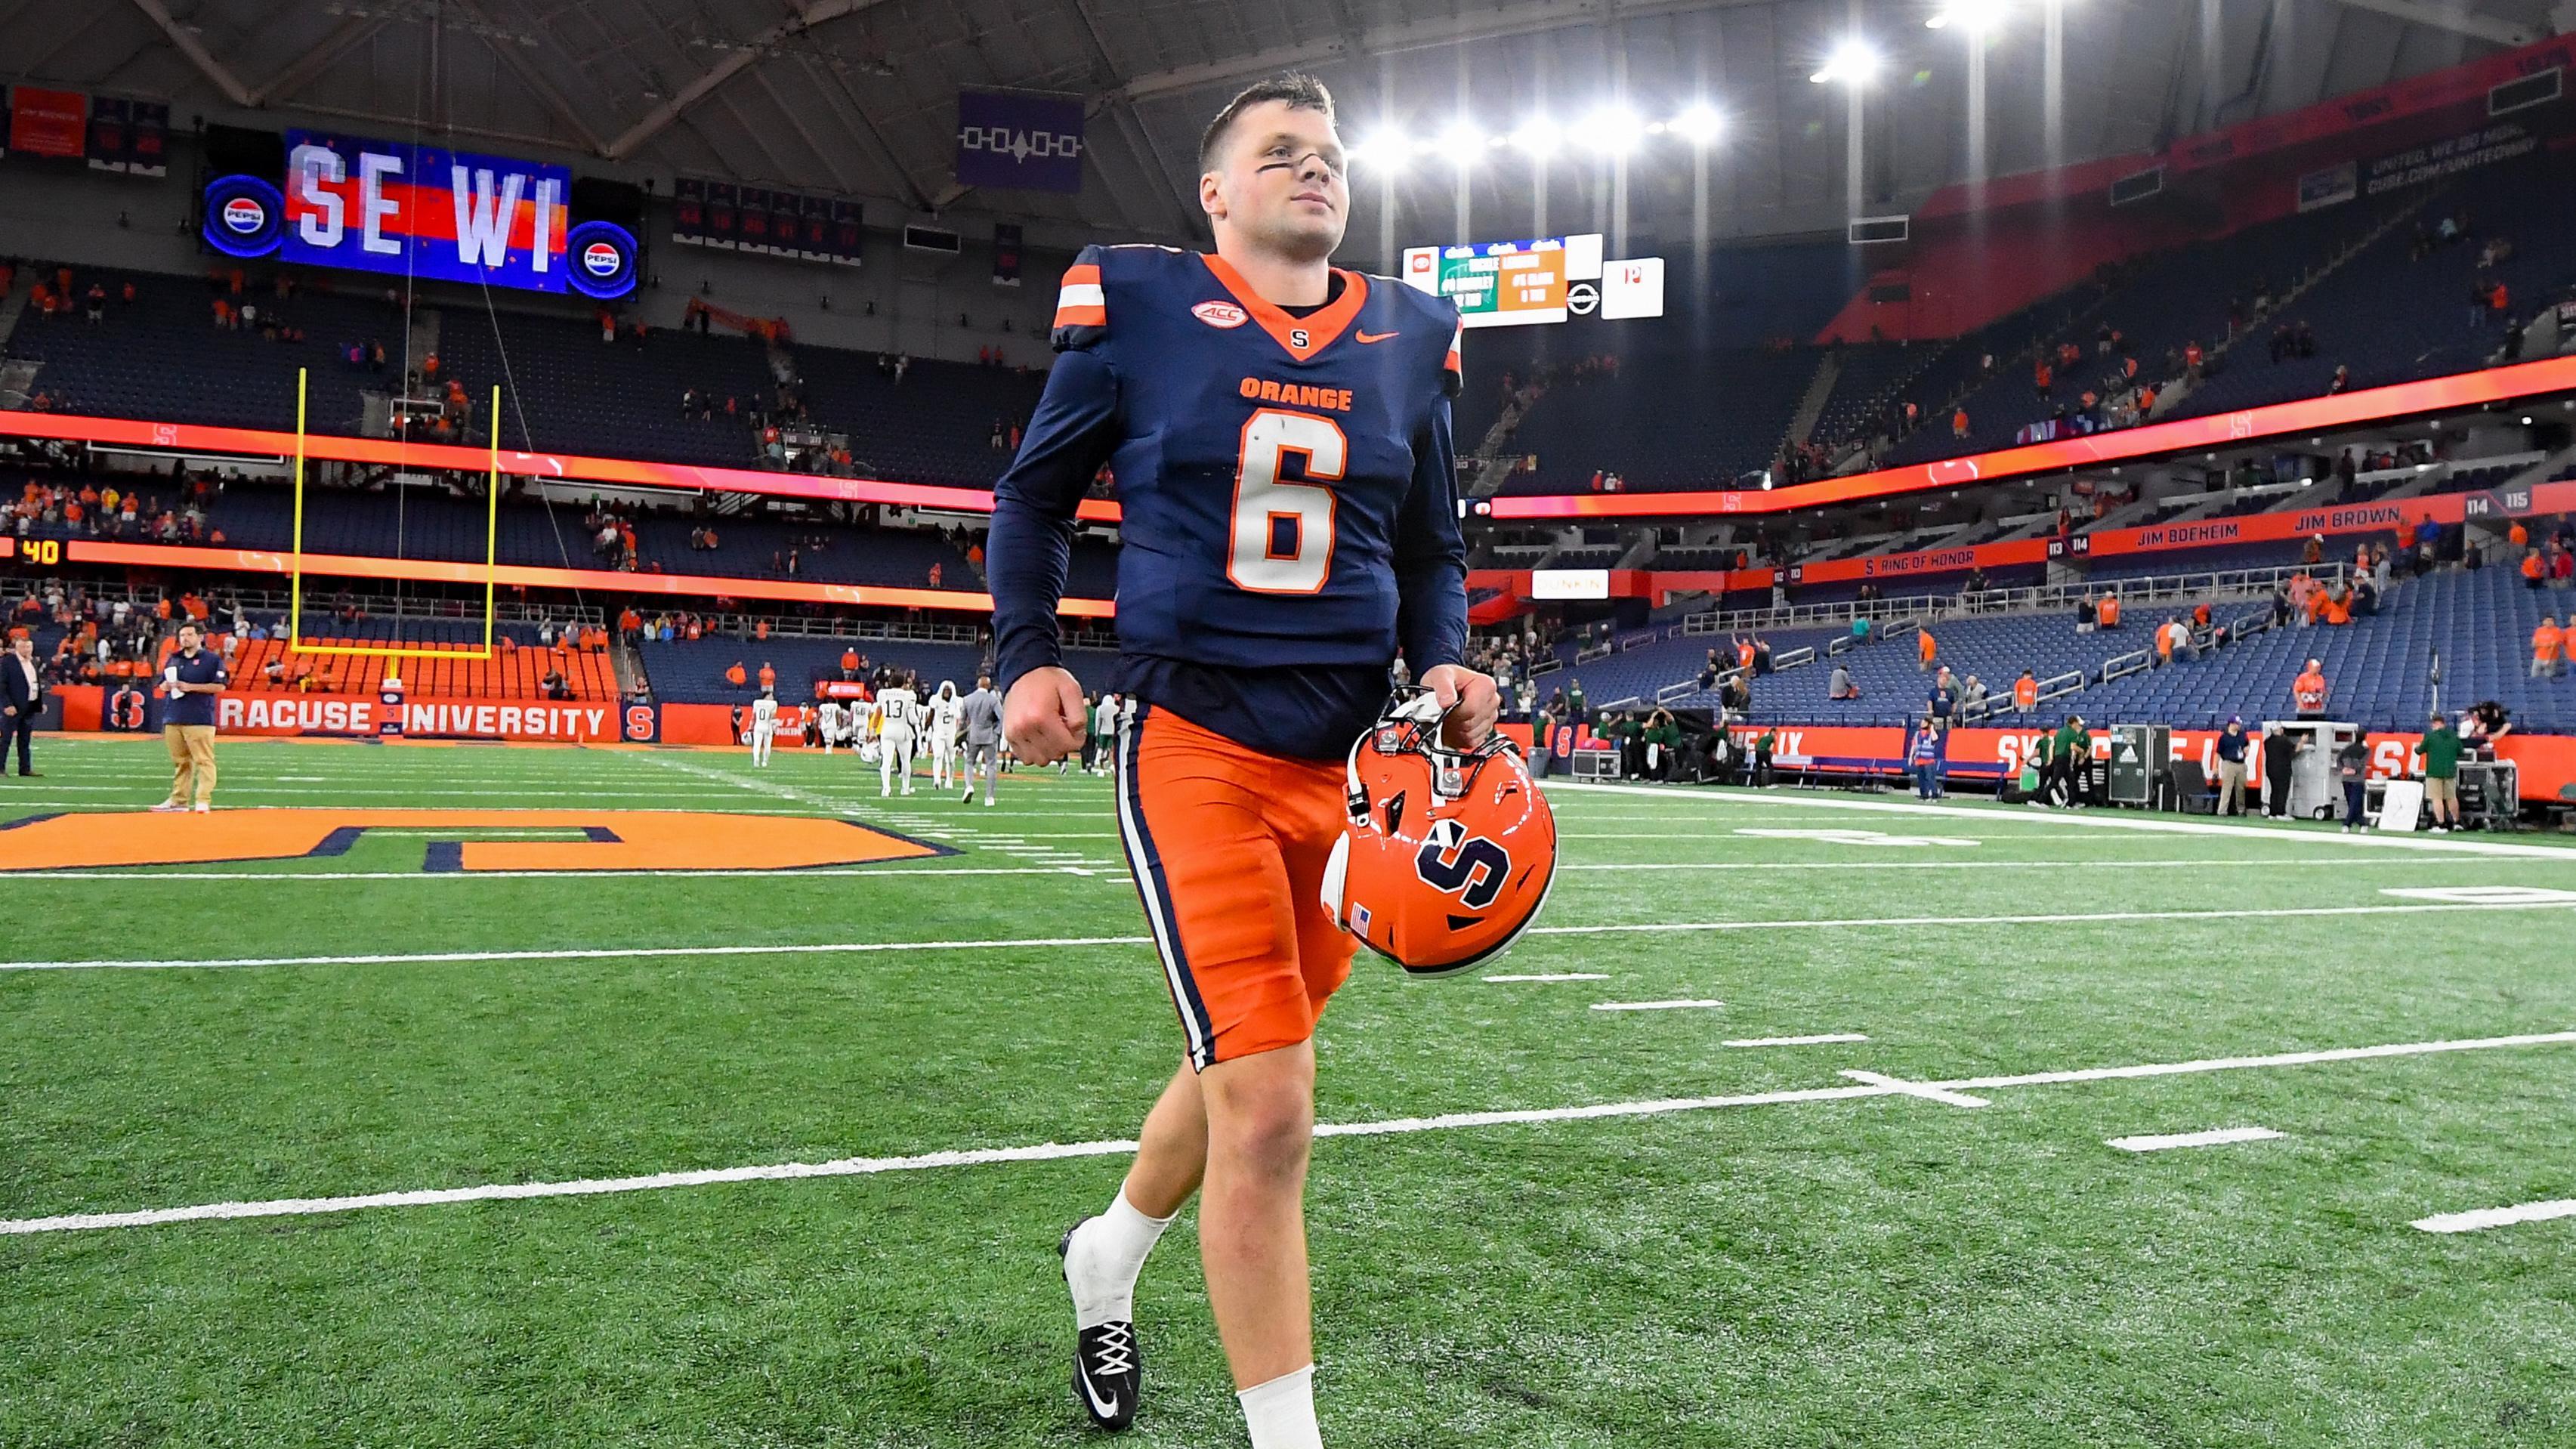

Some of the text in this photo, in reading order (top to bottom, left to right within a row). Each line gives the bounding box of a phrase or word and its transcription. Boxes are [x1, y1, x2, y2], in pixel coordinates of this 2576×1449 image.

[227, 210, 261, 220] PEPSI
[290, 144, 403, 255] SE
[451, 165, 561, 273] WI
[588, 254, 616, 264] PEPSI
[1198, 307, 1239, 321] ACC
[1290, 329, 1310, 349] S
[1240, 377, 1353, 412] ORANGE
[1226, 408, 1348, 595] 6
[2467, 491, 2528, 514] 114 115
[2295, 507, 2401, 532] JIM BROWN
[2049, 537, 2088, 556] 113 114
[2137, 524, 2238, 547] JIM BOEHEIM
[23, 540, 59, 565] 40
[1866, 551, 1974, 575] S RING OF HONOR
[220, 698, 371, 731] RACUSE
[885, 699, 903, 719] 13
[627, 706, 654, 740] S
[1557, 726, 1572, 758] S
[1414, 818, 1512, 910] S
